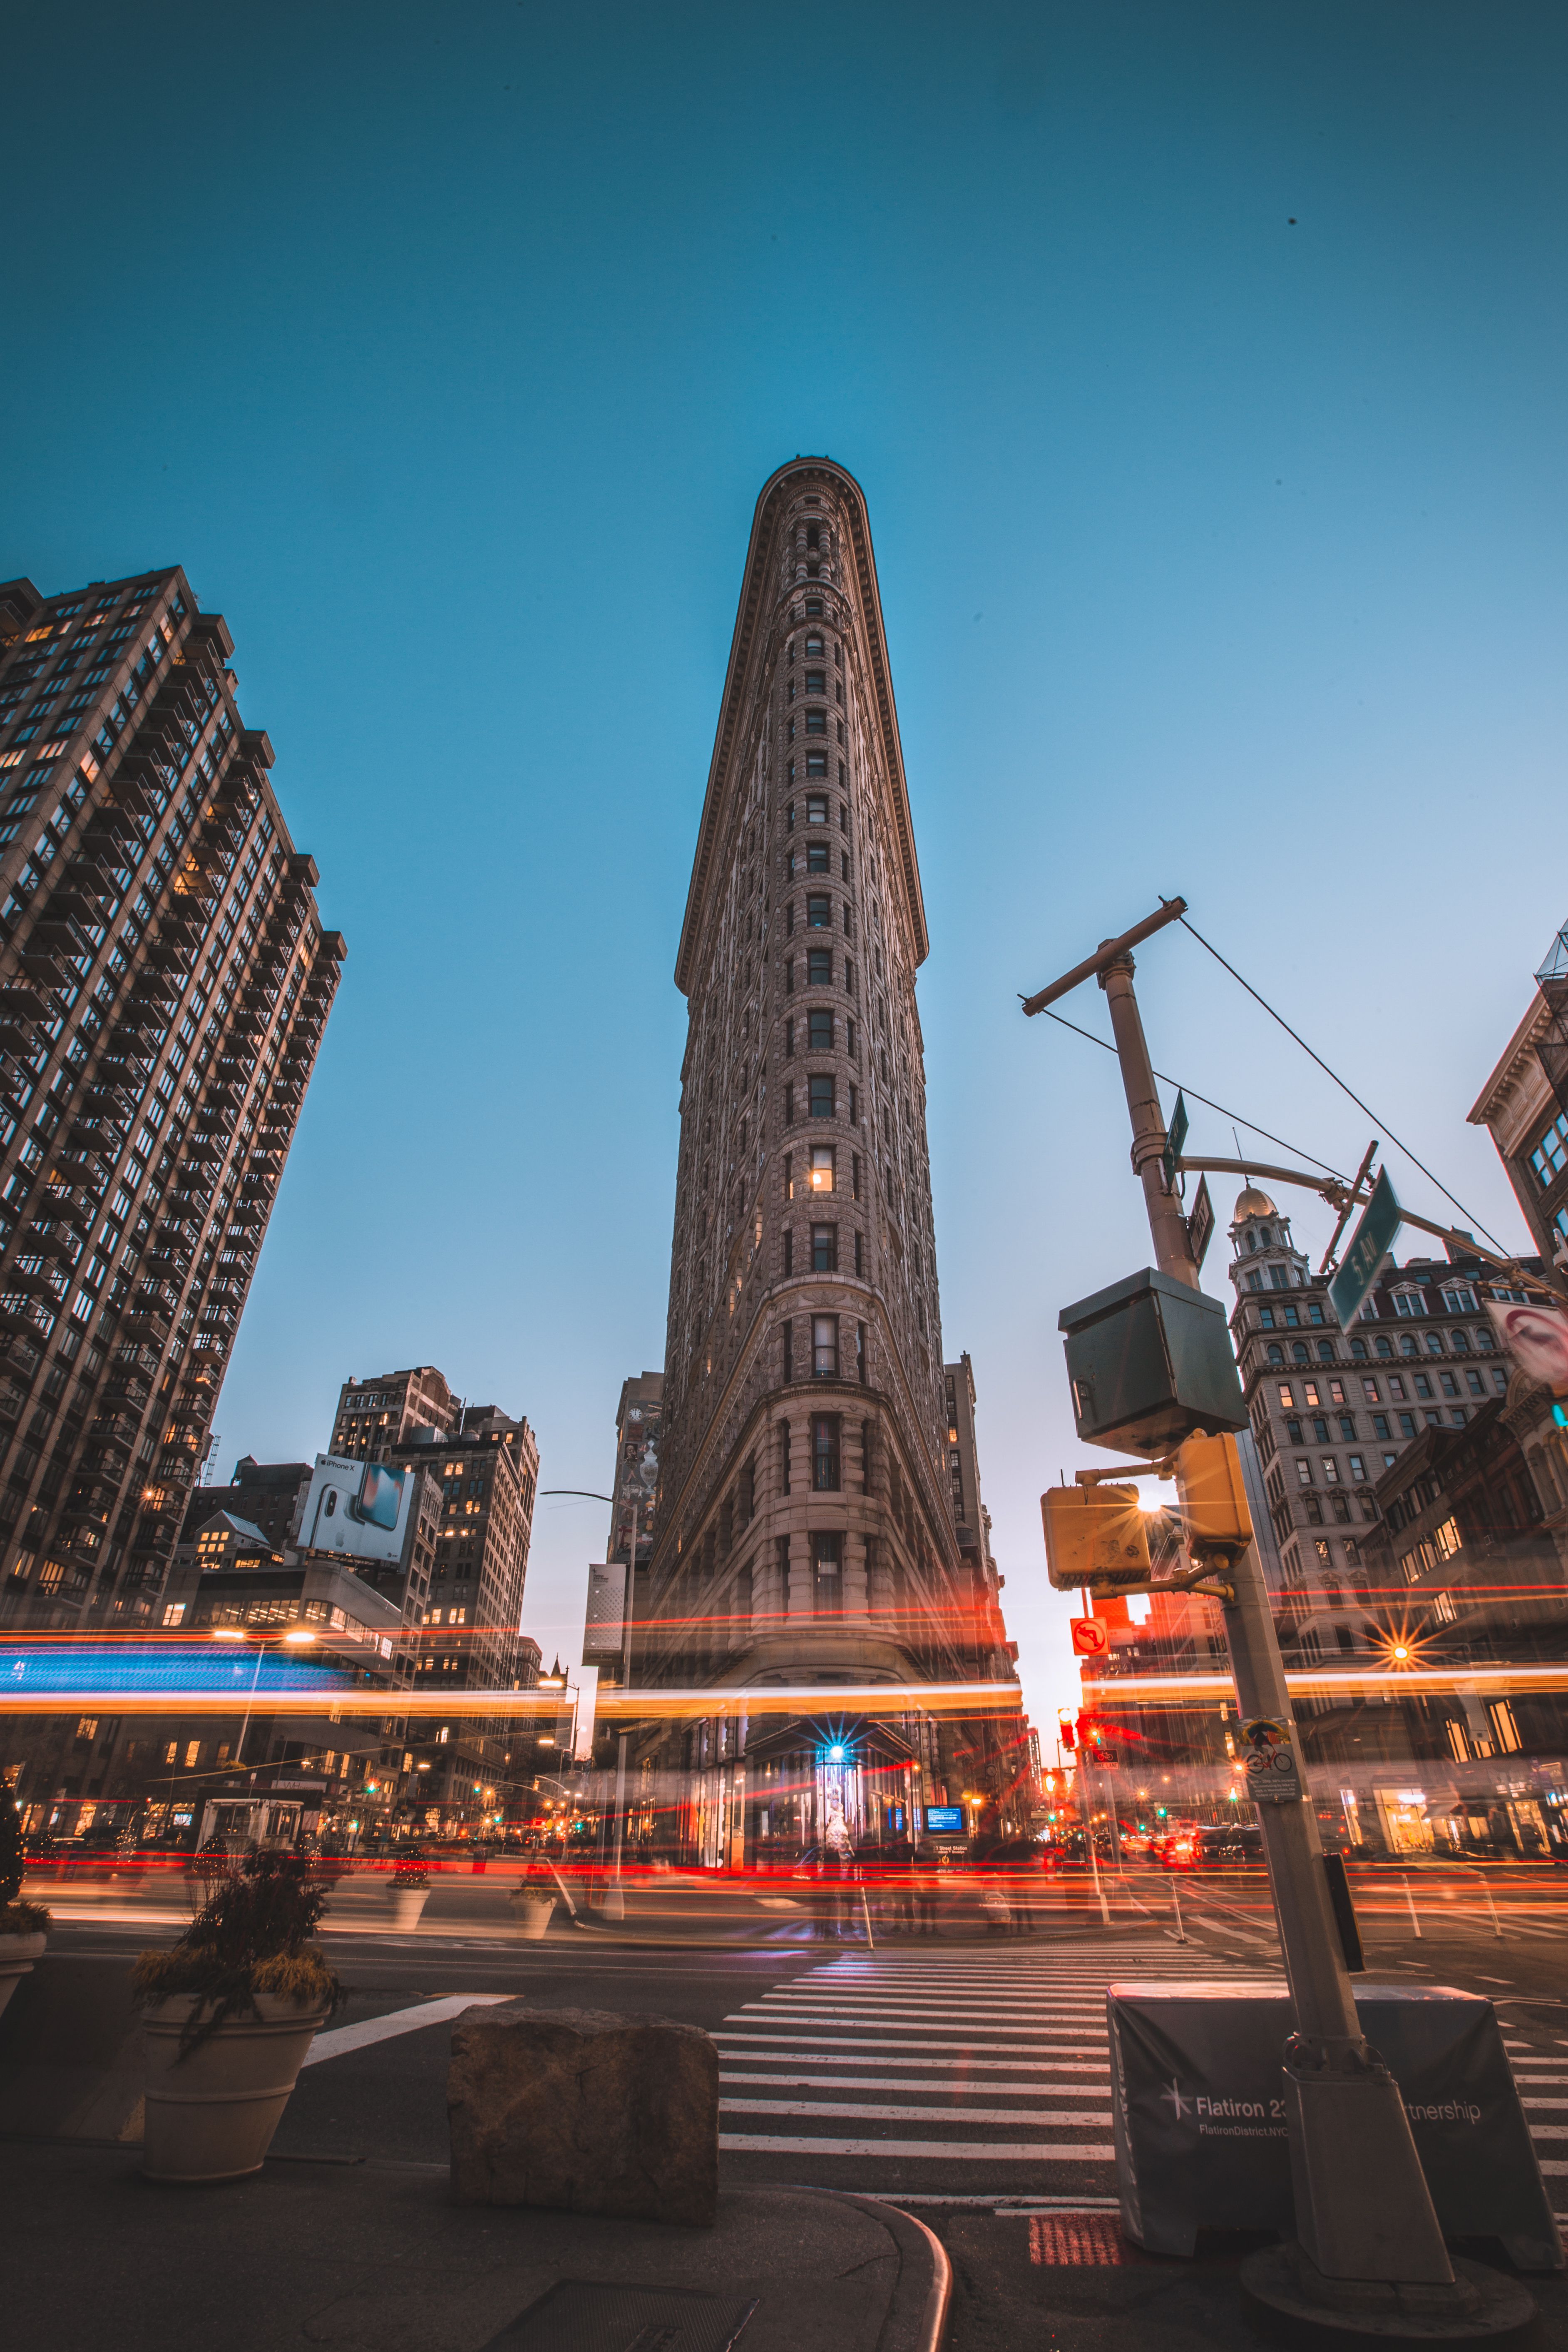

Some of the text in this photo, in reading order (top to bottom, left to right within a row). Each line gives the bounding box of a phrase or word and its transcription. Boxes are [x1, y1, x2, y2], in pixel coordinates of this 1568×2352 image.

[1351, 1231, 1377, 1285] 5 AV
[326, 1460, 349, 1470] iPhone
[1196, 2096, 1265, 2118] Flatiron
[1404, 2100, 1481, 2125] tnership
